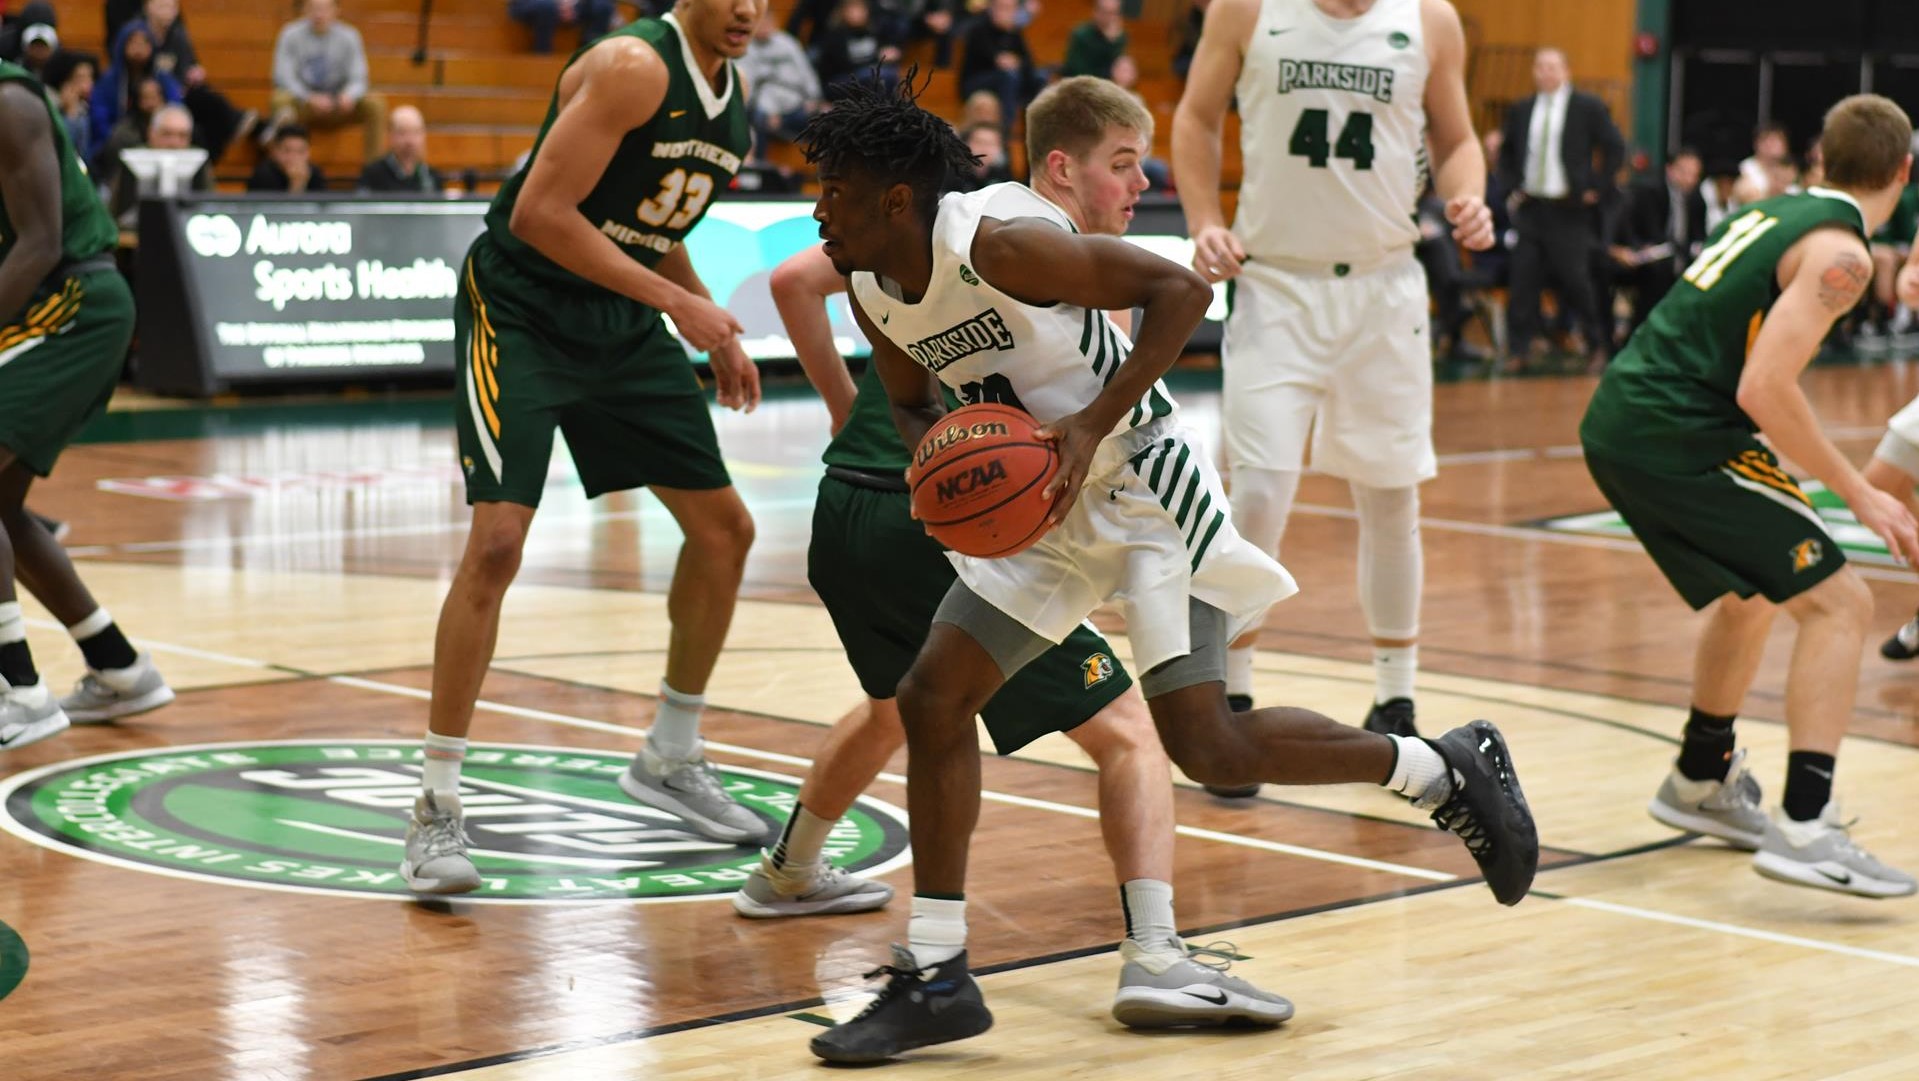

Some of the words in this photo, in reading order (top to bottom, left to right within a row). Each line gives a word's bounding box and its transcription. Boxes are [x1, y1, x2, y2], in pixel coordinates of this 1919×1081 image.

[1278, 58, 1394, 104] PARKSIDE
[1288, 108, 1375, 172] 44
[637, 167, 714, 230] 33
[245, 213, 352, 254] Aurora
[1682, 209, 1779, 292] 11
[254, 259, 353, 311] Sports
[356, 257, 458, 299] Health
[907, 307, 1015, 373] PARKSIDE
[917, 421, 1009, 467] Wilson
[936, 459, 1008, 502] NCAA
[244, 860, 508, 890] LKES
